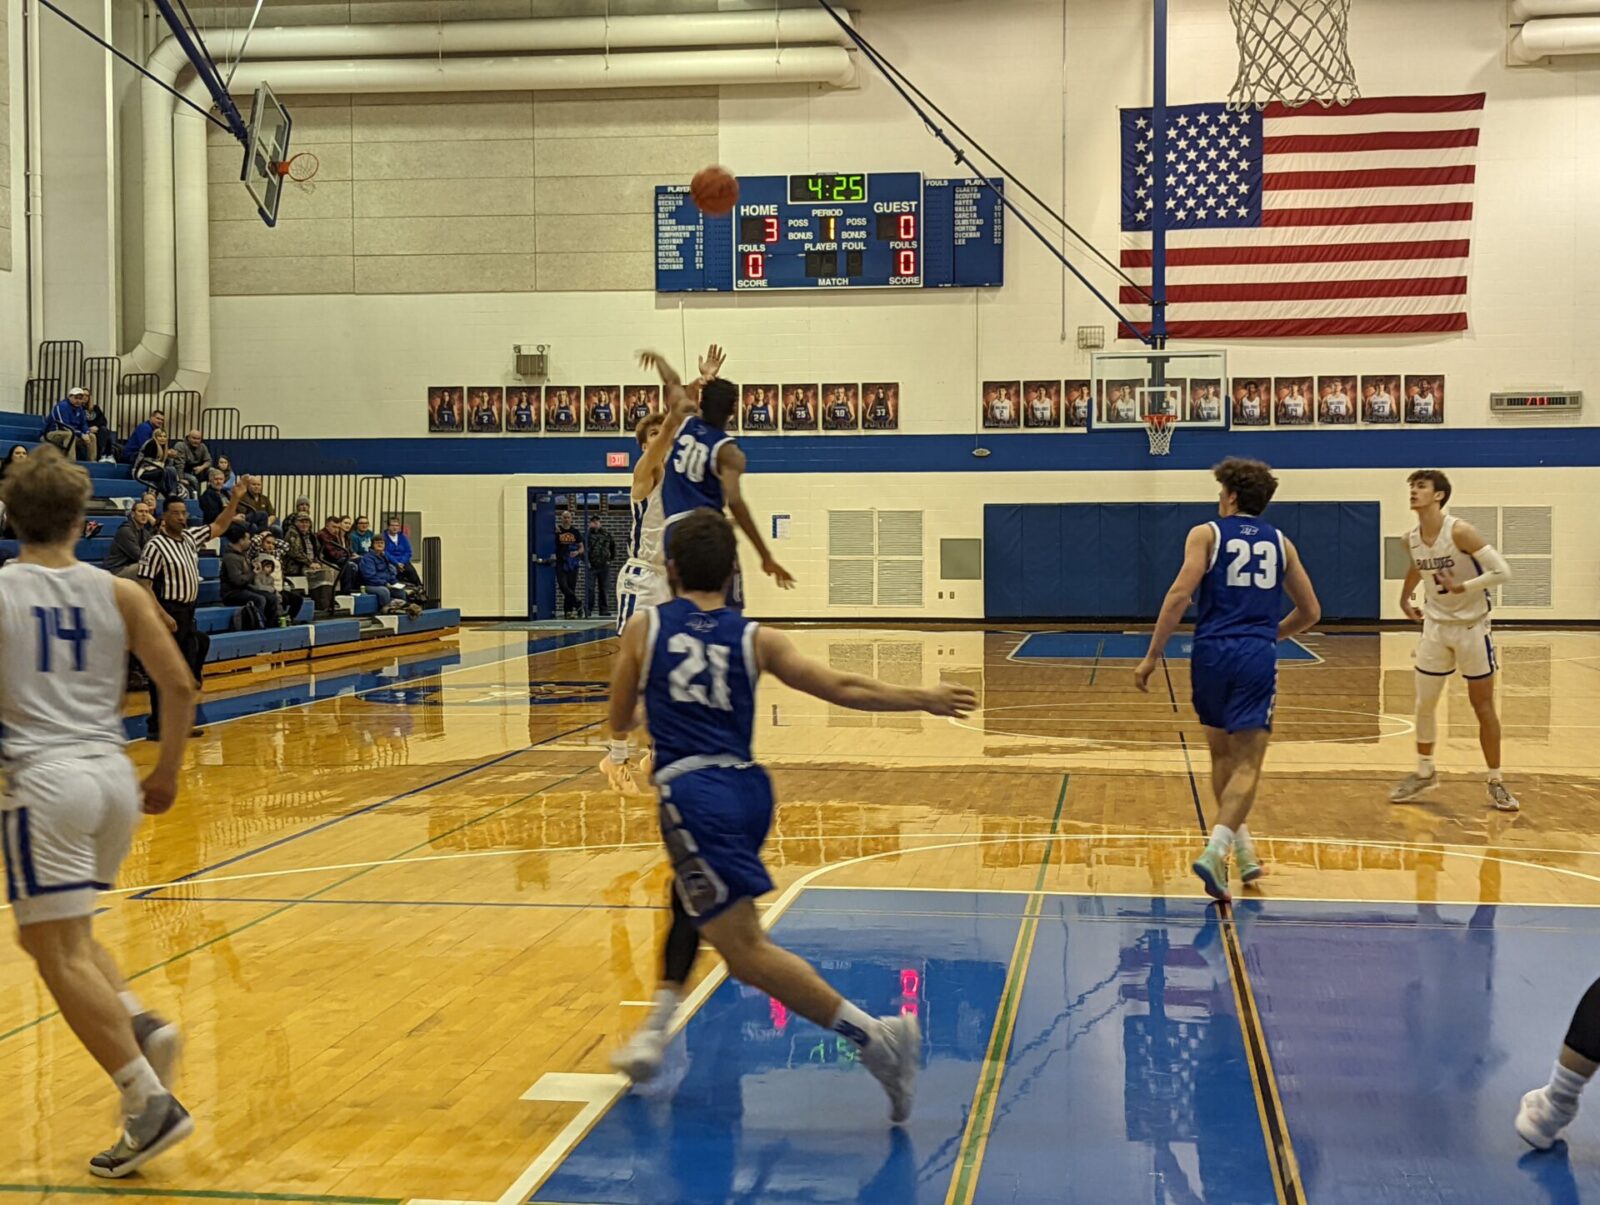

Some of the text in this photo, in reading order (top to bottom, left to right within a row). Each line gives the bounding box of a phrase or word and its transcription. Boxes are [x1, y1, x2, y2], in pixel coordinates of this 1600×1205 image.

[808, 176, 862, 200] 4:25
[740, 205, 778, 216] HOME
[811, 208, 844, 217] PERIOD
[873, 202, 918, 213] GUEST
[788, 219, 809, 227] POSS
[846, 218, 867, 226] POSS
[900, 215, 914, 239] 0
[765, 218, 778, 242] 3
[829, 217, 835, 240] 1
[788, 232, 813, 240] BONUS
[841, 231, 867, 239] BONUS
[738, 244, 766, 253] FOULS
[804, 242, 867, 251] PLAYER FOUL
[890, 241, 918, 249] FOULS
[749, 254, 762, 278] 0
[900, 251, 914, 274] 0
[737, 279, 768, 288] SCORE
[818, 278, 849, 286] MATCH
[889, 277, 920, 285] SCORE
[672, 434, 711, 484] 30
[1226, 538, 1277, 590] 23
[31, 605, 92, 673] 14
[667, 632, 734, 711] 21
